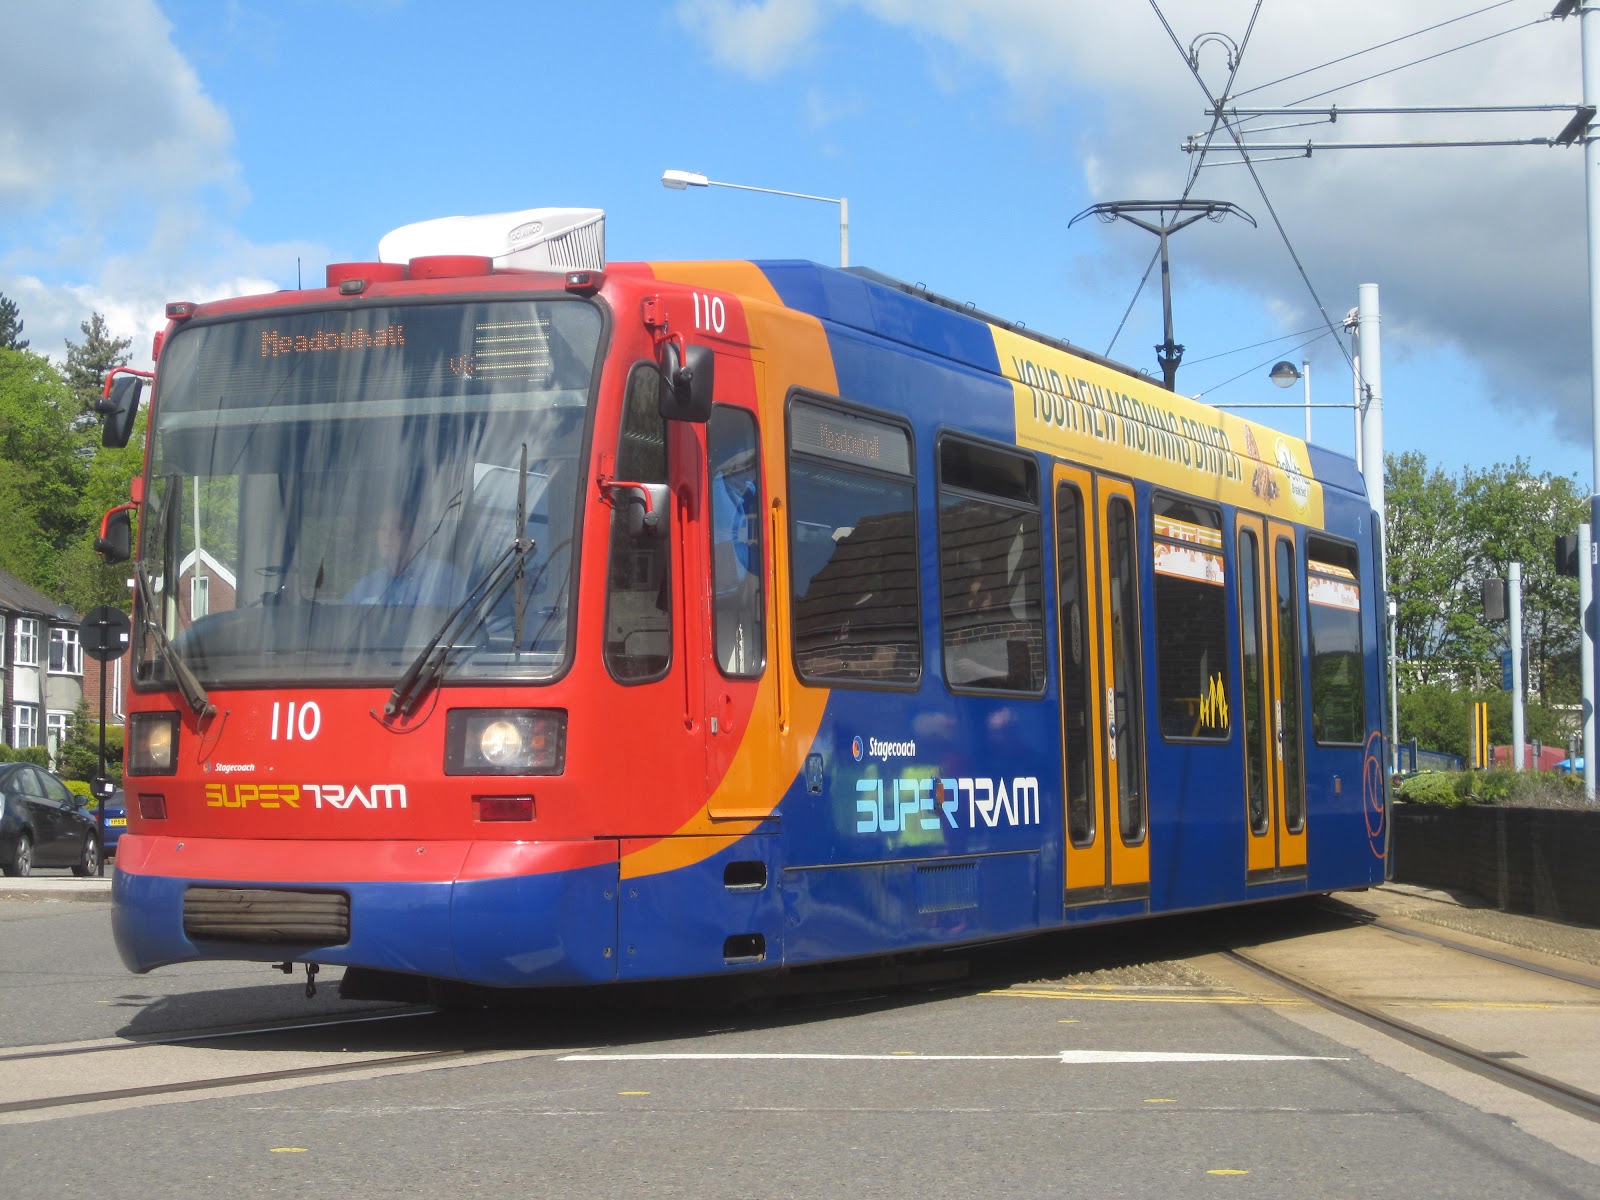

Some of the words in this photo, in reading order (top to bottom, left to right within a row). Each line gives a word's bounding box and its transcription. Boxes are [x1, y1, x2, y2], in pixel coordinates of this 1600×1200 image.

[692, 291, 726, 334] 110
[261, 325, 405, 358] Meadowhall
[1011, 355, 1079, 432] YOUR
[1065, 373, 1117, 443] NEW
[1106, 387, 1192, 468] MORNING
[1180, 415, 1243, 482] DRIVER
[271, 701, 321, 741] 110
[869, 736, 916, 762] Stagecoach
[214, 762, 255, 774] Stagecoach
